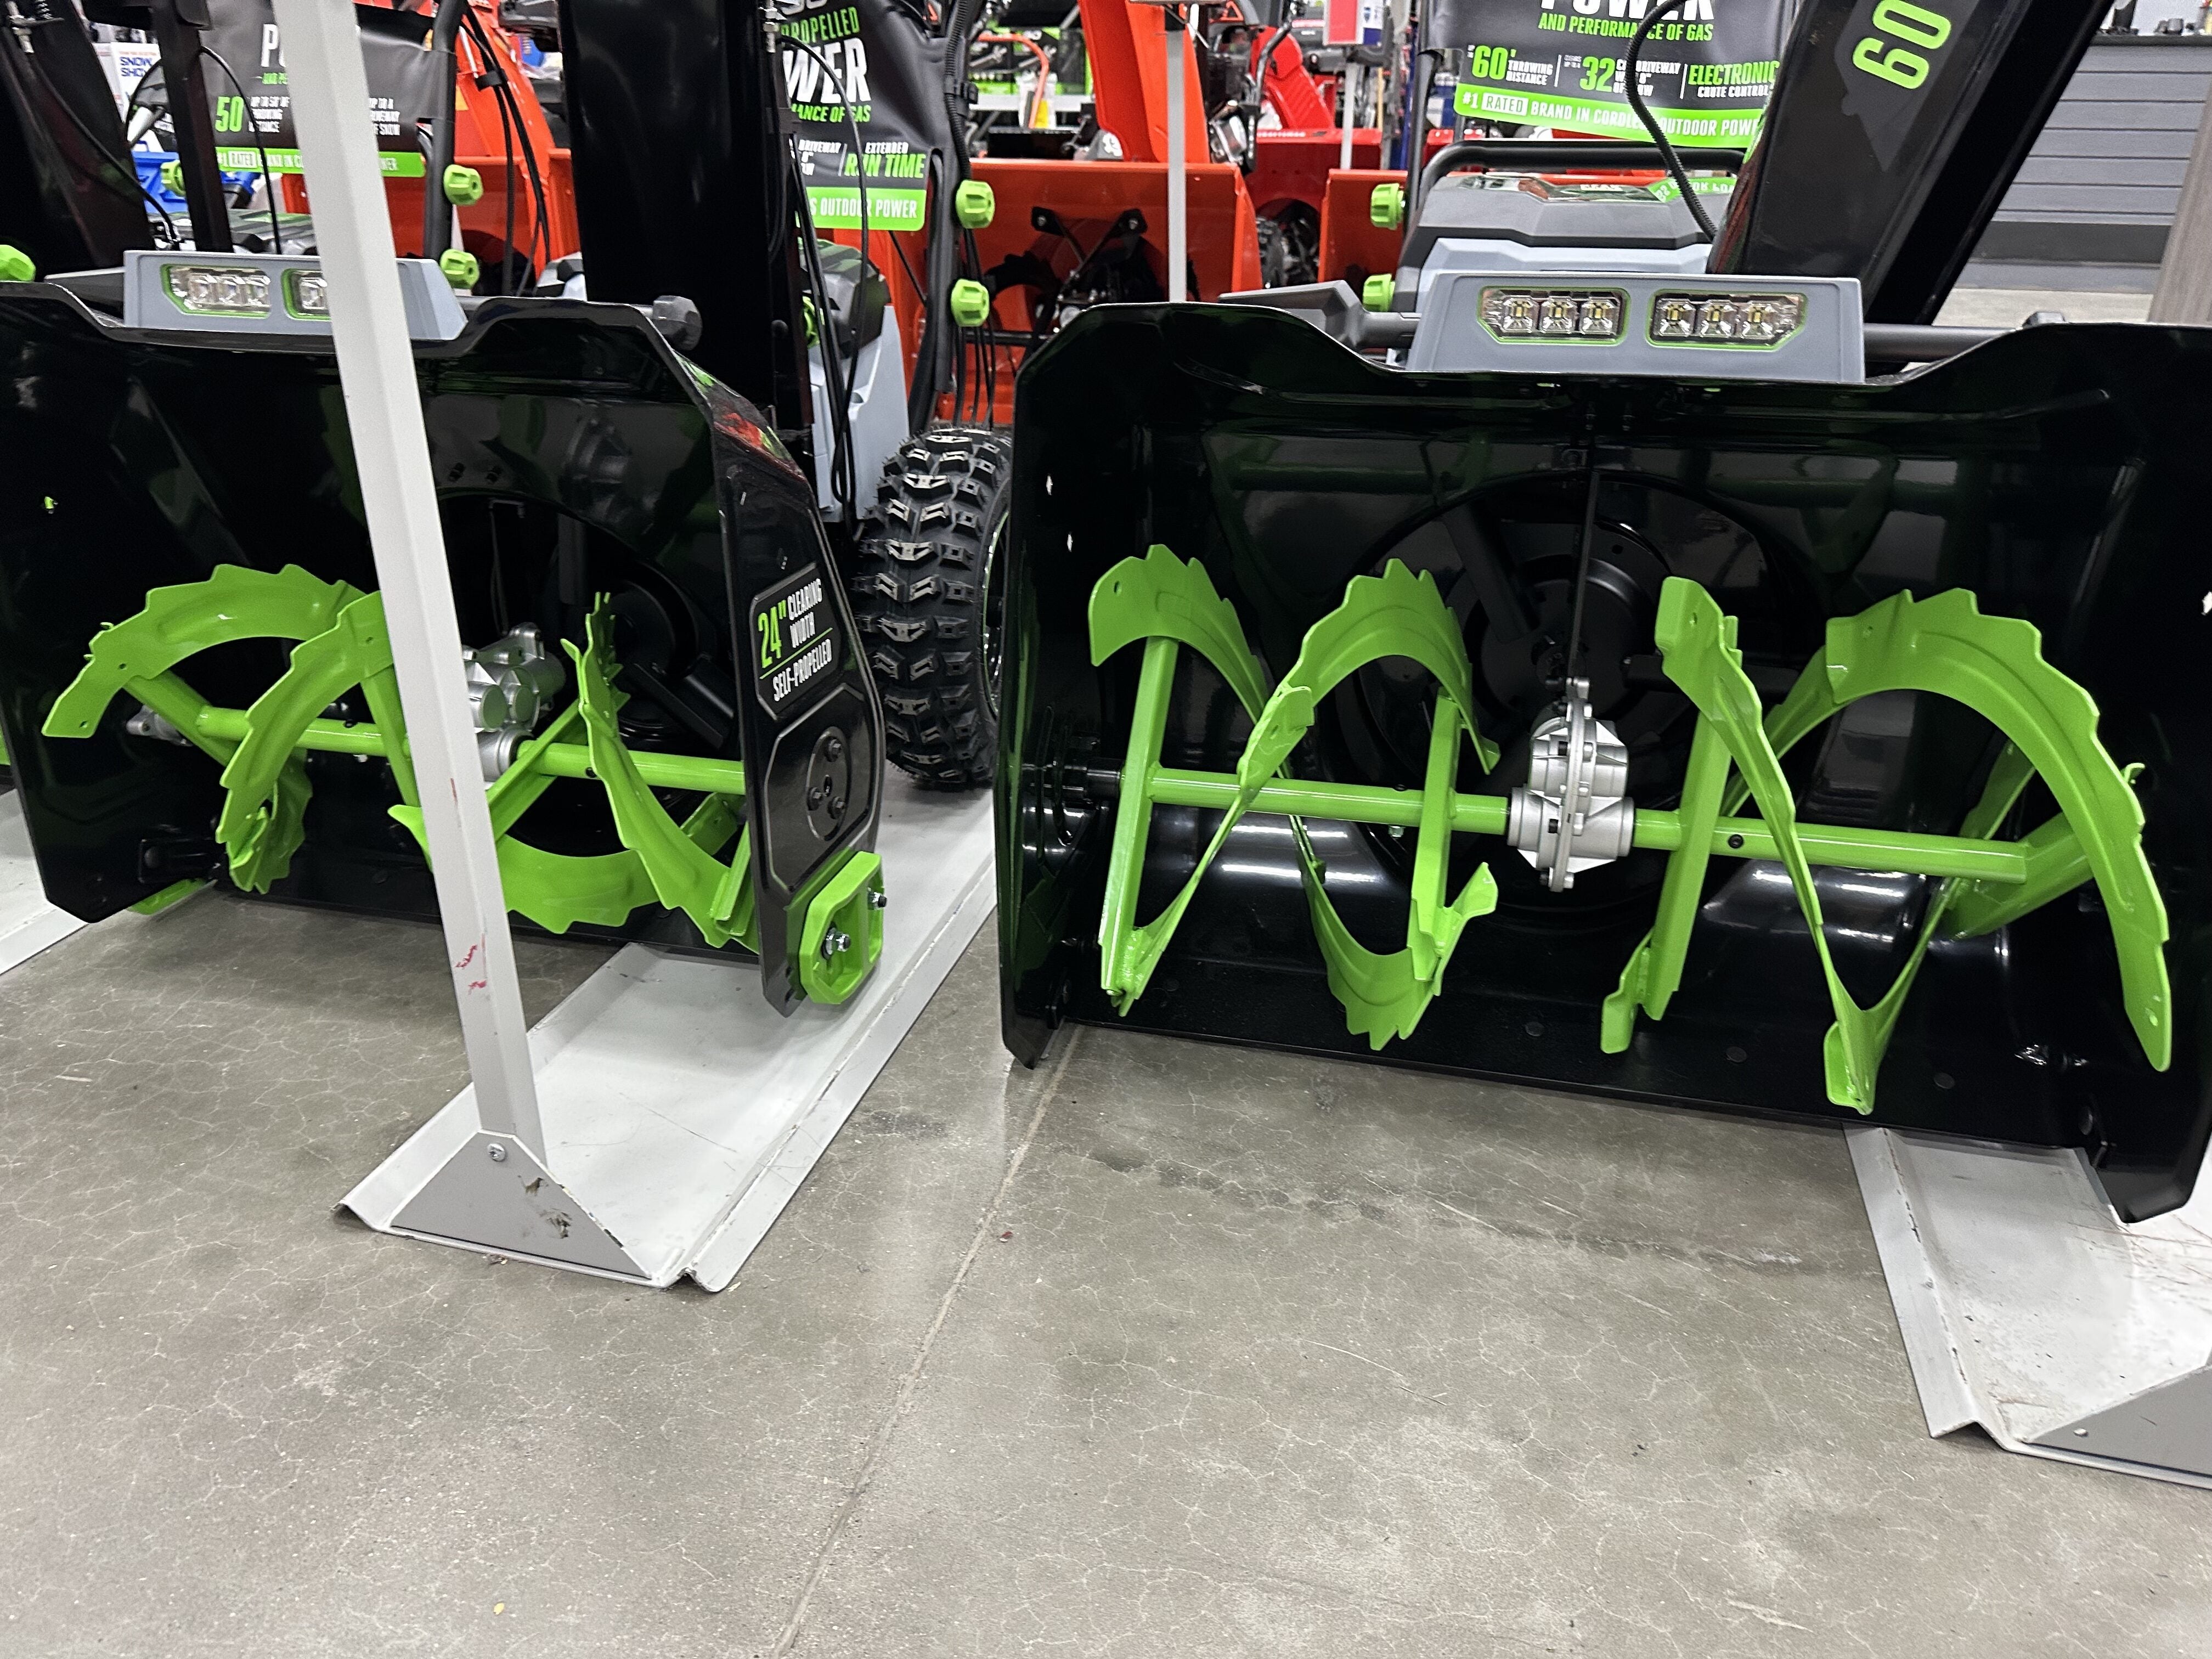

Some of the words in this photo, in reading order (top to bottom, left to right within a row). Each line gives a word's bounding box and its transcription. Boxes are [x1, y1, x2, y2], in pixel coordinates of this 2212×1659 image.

[781, 7, 860, 44] PROPELLED
[1538, 13, 1566, 31] AND
[1568, 16, 1664, 40] PERFORMACE
[1666, 24, 1684, 41] OF
[1686, 24, 1714, 41] GAS
[1852, 0, 1952, 89] 60
[121, 67, 146, 77] SHO
[1505, 71, 1549, 86] DISTANCE
[1508, 60, 1554, 76] THROWING
[1579, 57, 1616, 92] 32
[1635, 60, 1681, 74] DRIVEWAY
[1688, 60, 1780, 85] ELECTRONIC
[1697, 86, 1726, 98] CHUTE
[215, 96, 245, 132] 50
[829, 106, 846, 123] OF
[1462, 92, 1479, 109] #1
[1486, 95, 1523, 113] RATED
[1531, 101, 1572, 120] BRAND
[1576, 107, 1590, 122] IN
[1593, 109, 1646, 131] CORDLE
[1659, 117, 1718, 136] OUTDOOR
[798, 139, 842, 154] DRIVEWAY
[865, 142, 909, 154] EXTENDED
[884, 154, 926, 178] TIME
[875, 199, 917, 218] POWER
[787, 578, 822, 620] CLEARING
[789, 612, 816, 648] WIDTH
[772, 639, 832, 702] SELF-PROPELLED
